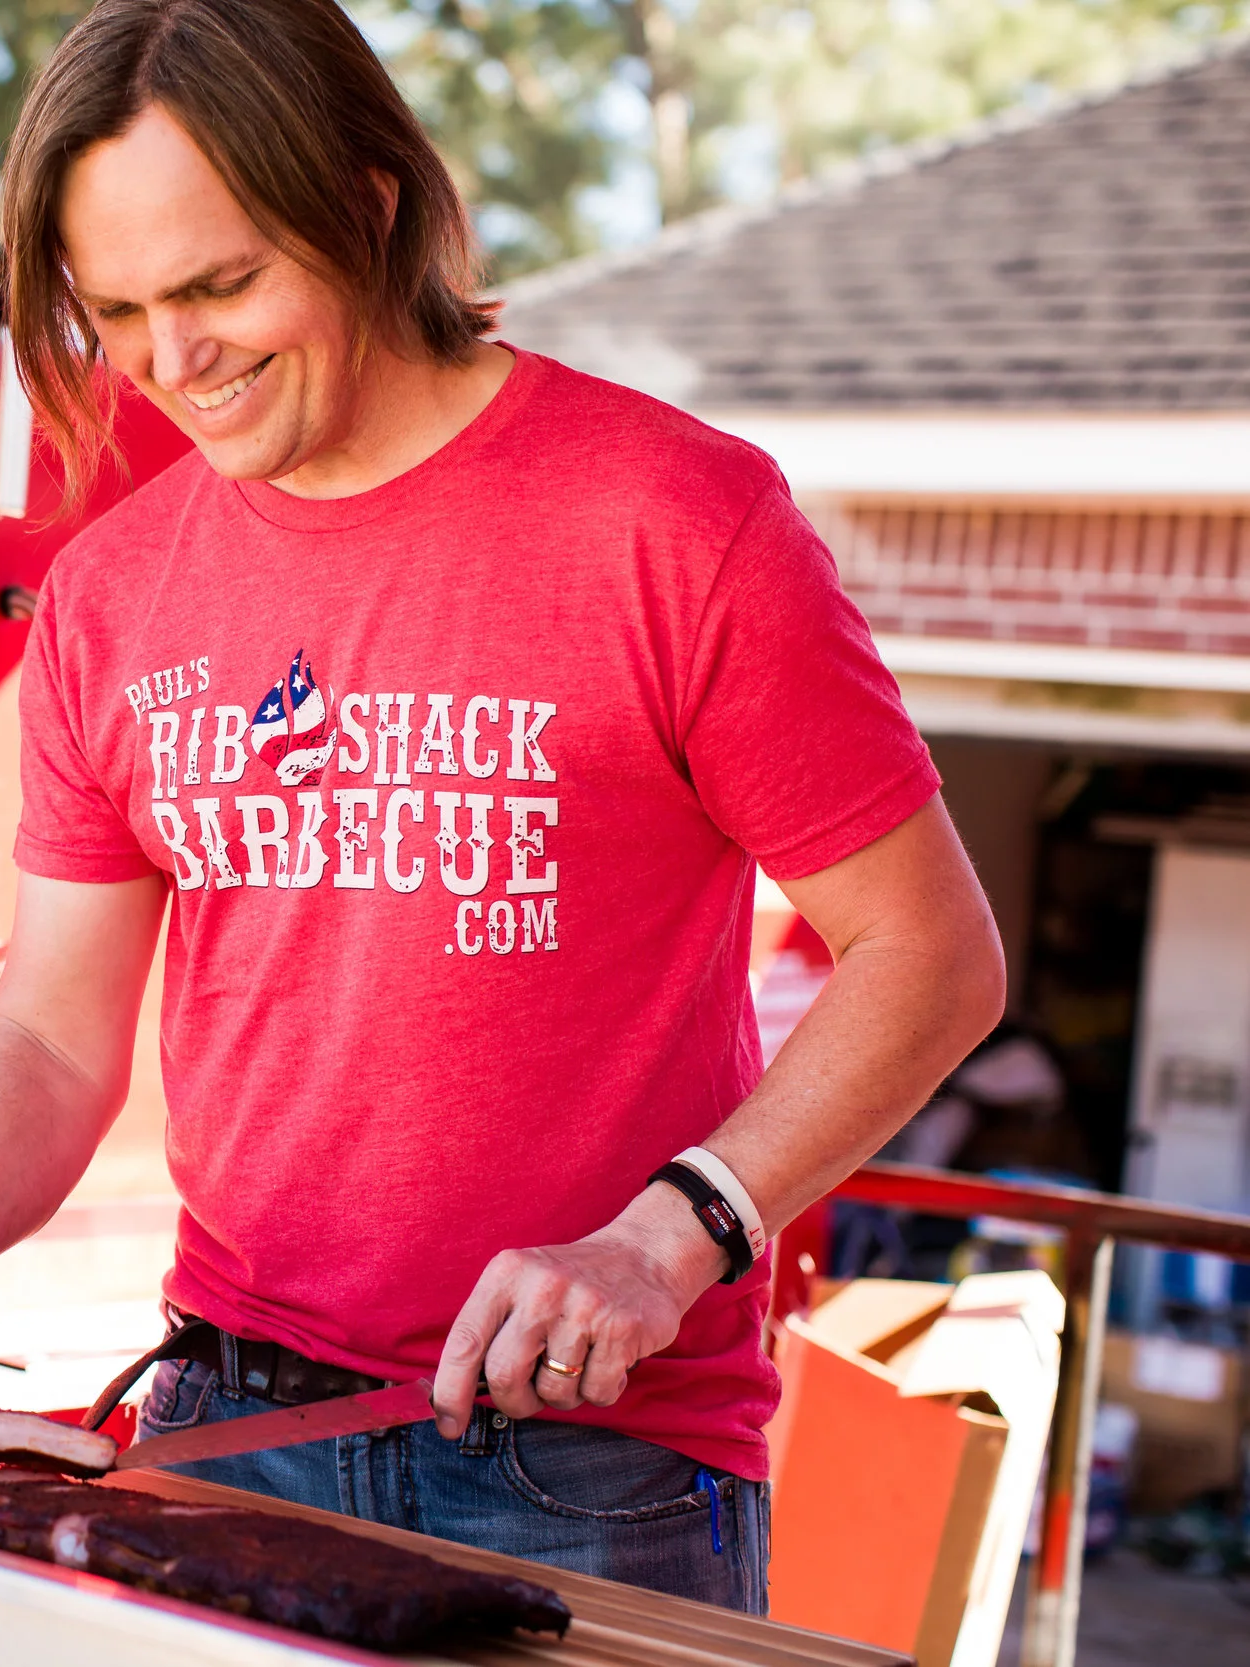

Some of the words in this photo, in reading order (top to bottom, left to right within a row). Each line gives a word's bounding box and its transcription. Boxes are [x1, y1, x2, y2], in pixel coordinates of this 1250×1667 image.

[125, 656, 211, 725] PAUL'S
[149, 704, 250, 799] RIB
[338, 693, 557, 786] SHACK
[151, 788, 558, 895] BARBECUE
[444, 898, 558, 955] .COM
